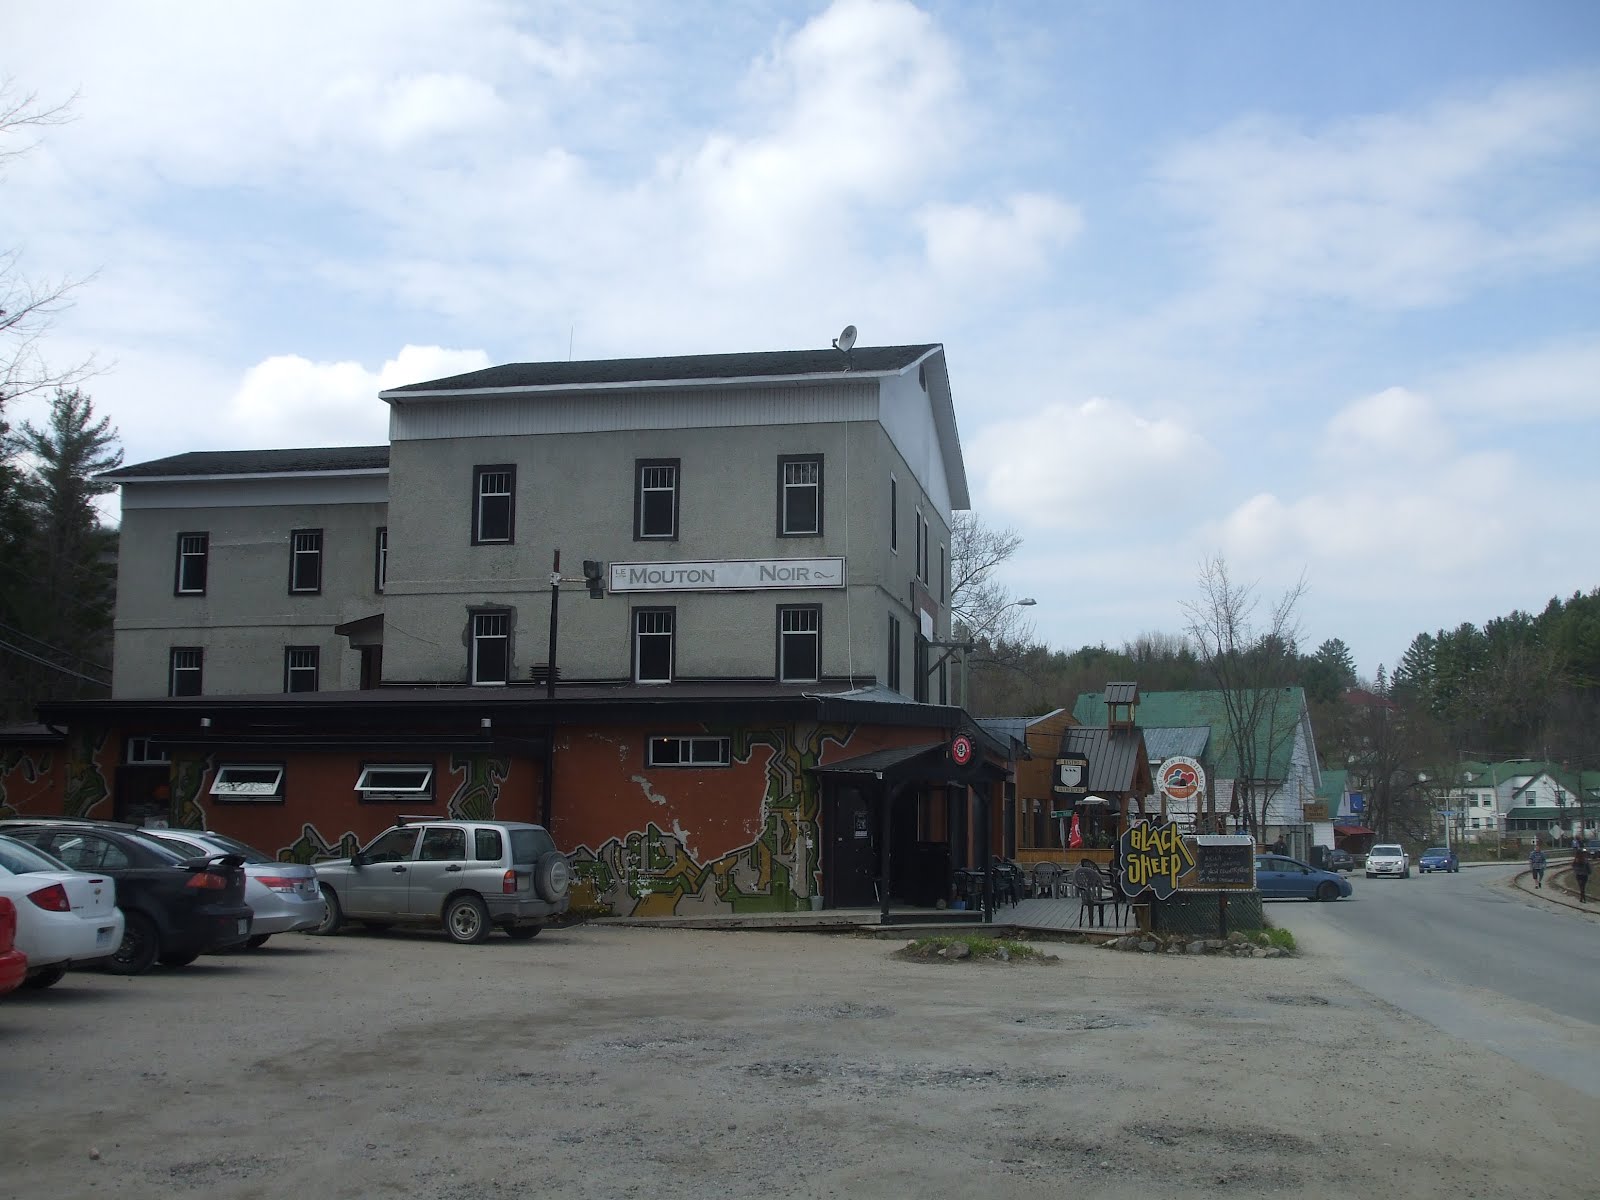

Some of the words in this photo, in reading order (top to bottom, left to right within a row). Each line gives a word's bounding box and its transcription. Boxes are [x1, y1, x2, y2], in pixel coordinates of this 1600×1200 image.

[629, 567, 715, 585] MOUTON
[759, 565, 810, 582] NOIR
[1130, 822, 1194, 866] BLACK
[1127, 853, 1181, 889] SHEEP
